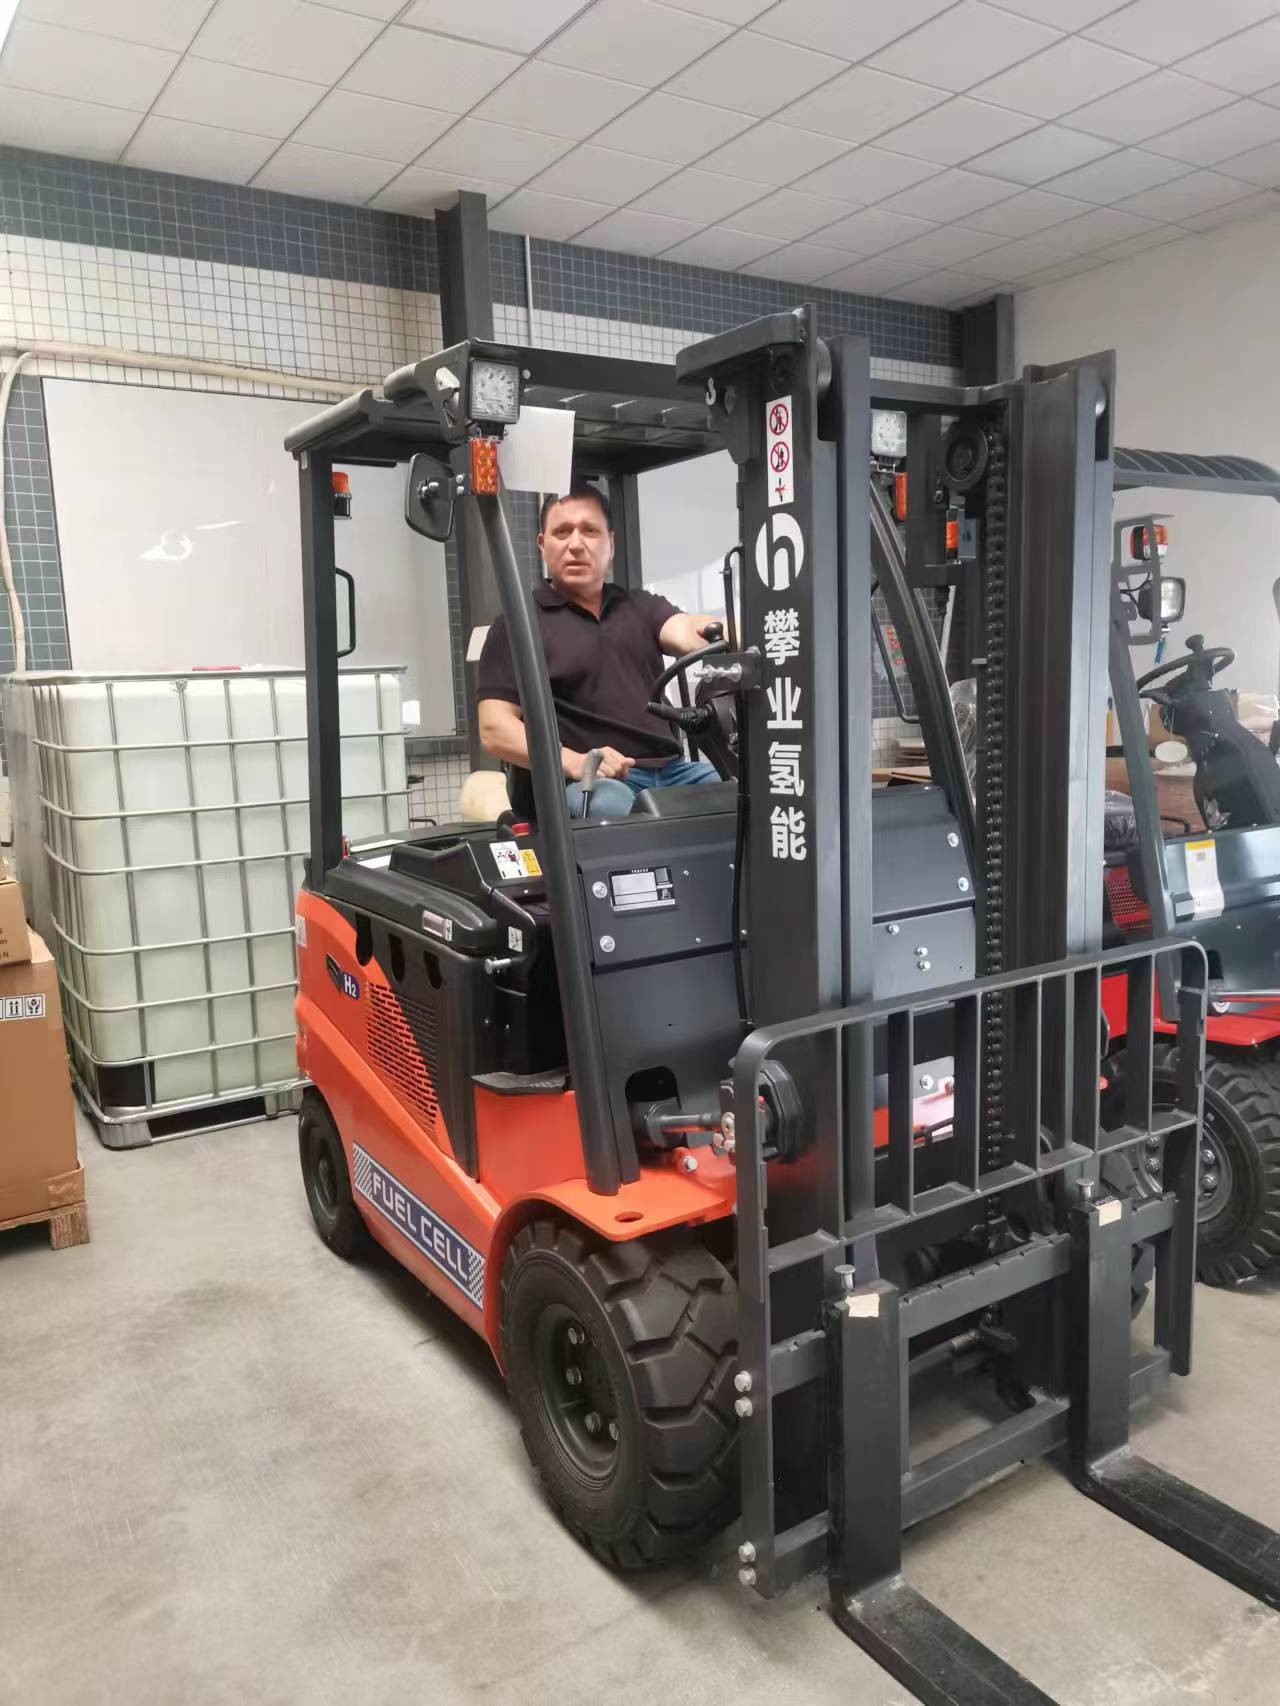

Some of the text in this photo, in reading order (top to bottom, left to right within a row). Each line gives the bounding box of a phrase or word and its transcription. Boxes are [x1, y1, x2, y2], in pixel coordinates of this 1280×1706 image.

[763, 607, 807, 861] 攀业氢能
[372, 1172, 468, 1281] FUEL CELL
